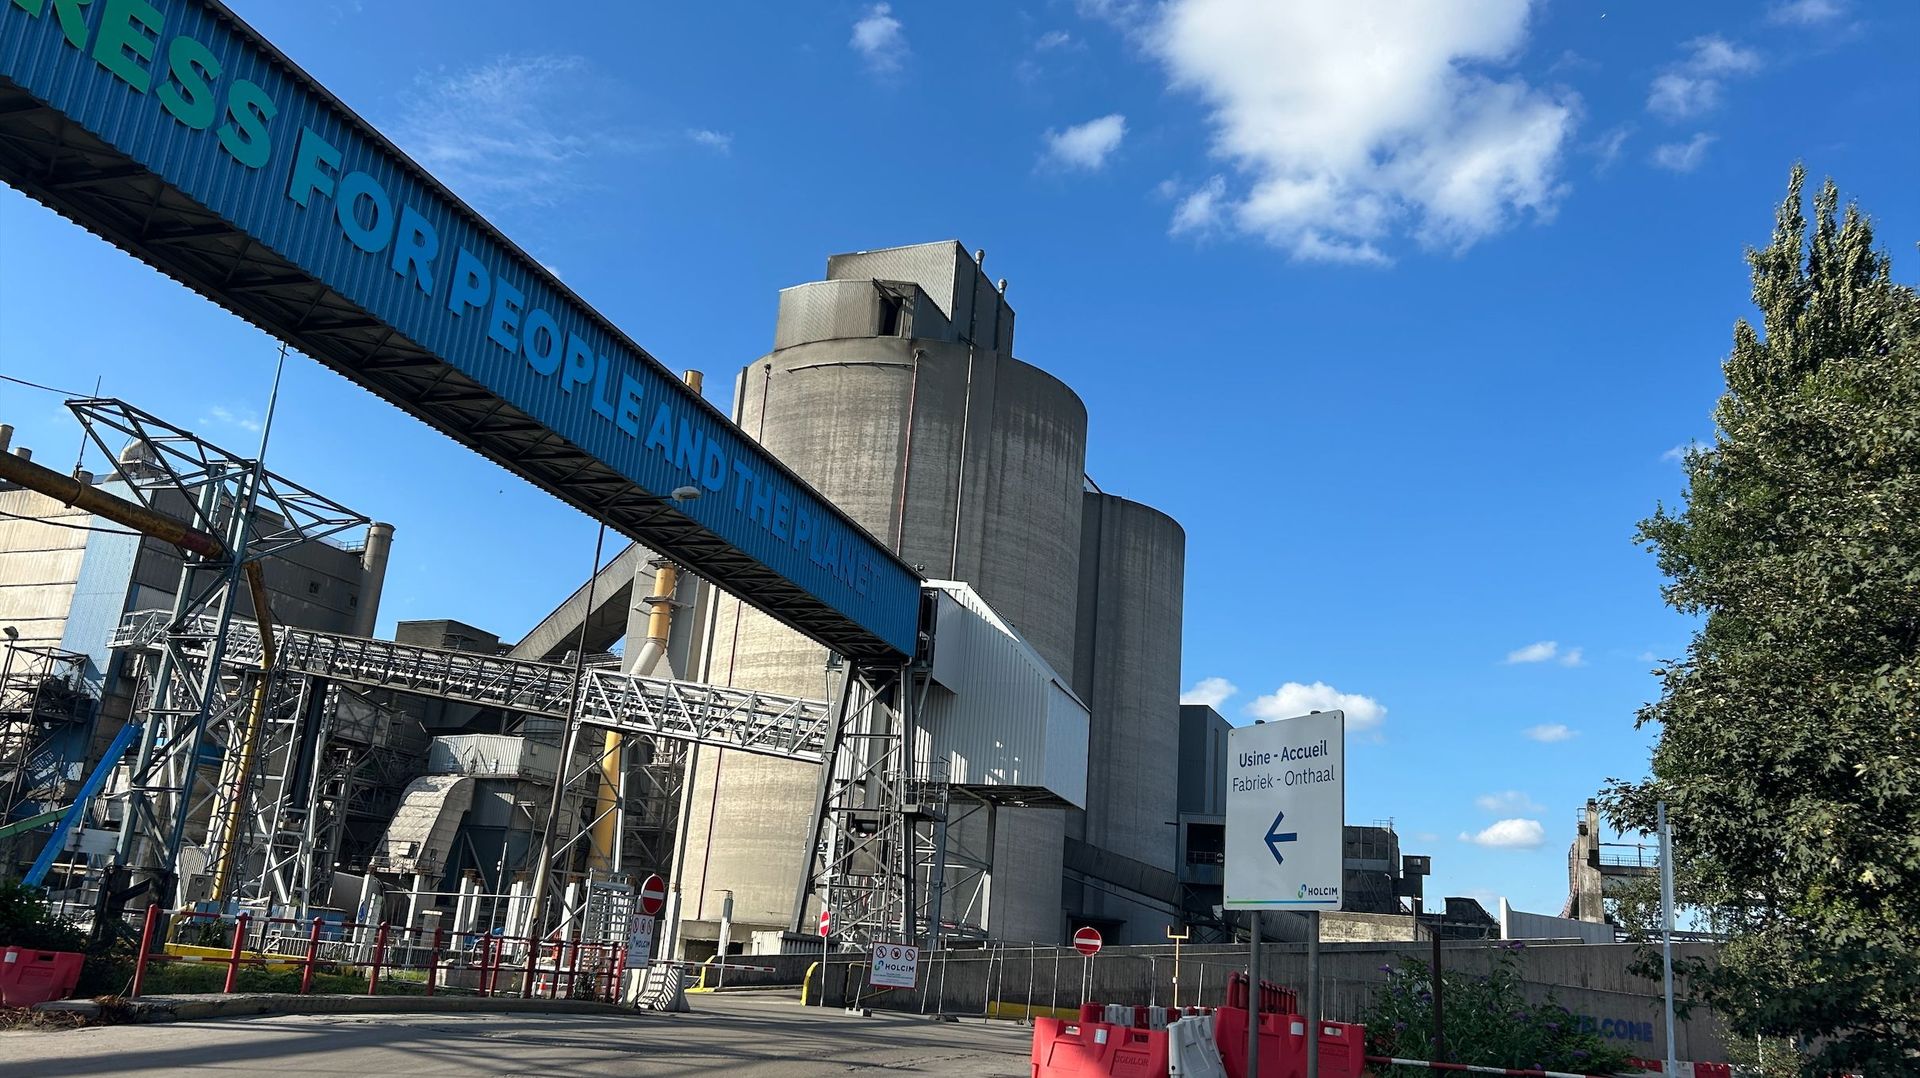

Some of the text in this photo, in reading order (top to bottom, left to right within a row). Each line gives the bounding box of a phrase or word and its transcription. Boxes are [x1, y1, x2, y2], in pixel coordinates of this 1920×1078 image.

[289, 126, 440, 296] FOR
[448, 246, 644, 439] PEOPLE
[645, 403, 728, 492] AND
[733, 457, 791, 542] THE
[793, 505, 881, 602] PLANET
[1239, 750, 1271, 768] Usine
[1281, 740, 1328, 762] Accueil
[1232, 773, 1273, 792] Fabriek
[1285, 765, 1335, 786] Onthaal
[1308, 887, 1338, 896] HOLCIM
[885, 963, 915, 973] HOLCIM
